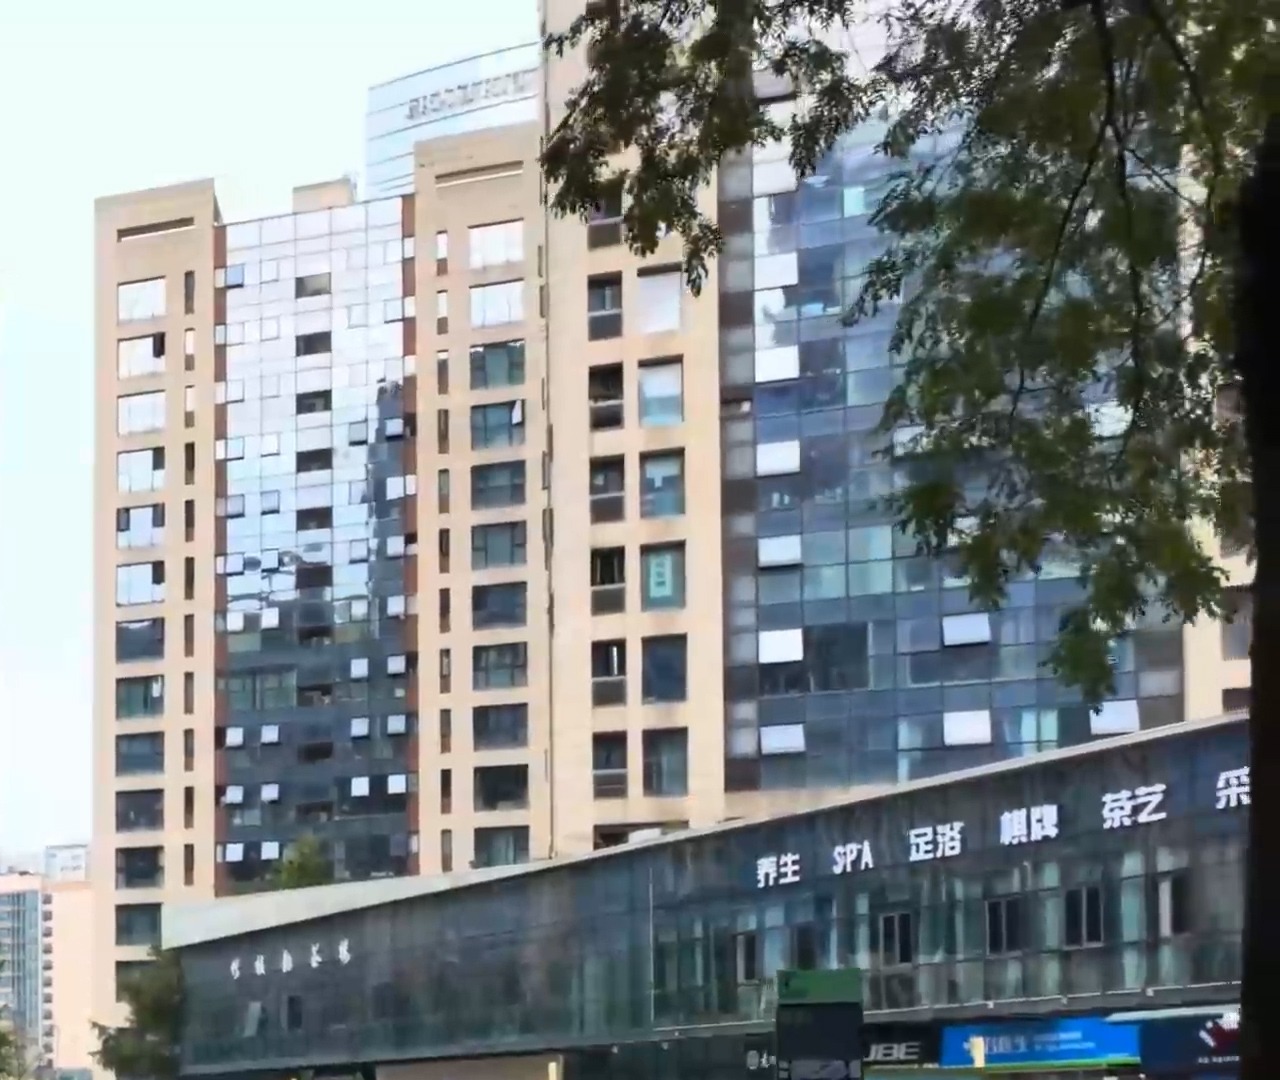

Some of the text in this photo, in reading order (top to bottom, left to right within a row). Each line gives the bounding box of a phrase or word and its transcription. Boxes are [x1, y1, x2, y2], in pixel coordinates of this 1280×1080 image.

[756, 852, 801, 888] 养生
[832, 839, 874, 874] SPA
[909, 821, 965, 862] 足浴
[1000, 804, 1058, 845] 棋牌
[1101, 783, 1167, 829] 茶艺
